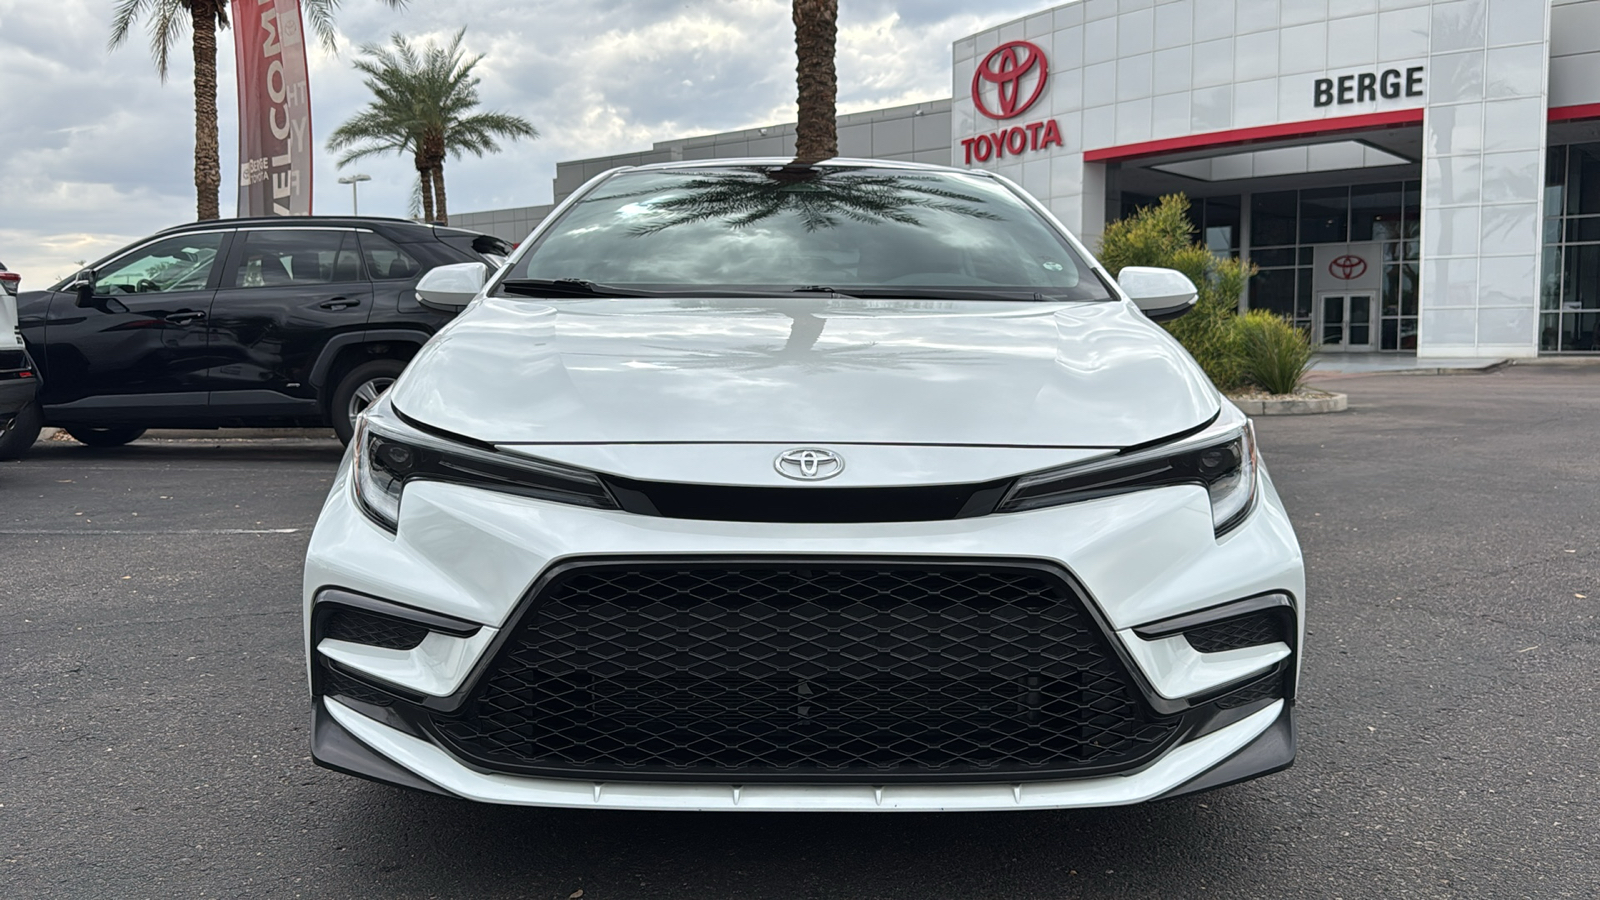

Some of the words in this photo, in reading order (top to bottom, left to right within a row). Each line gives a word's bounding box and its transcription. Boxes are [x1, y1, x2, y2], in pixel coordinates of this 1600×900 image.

[258, 0, 292, 216] ELCOM
[1313, 66, 1424, 108] BERGE
[961, 119, 1063, 165] TOYOTA
[249, 157, 269, 173] BERGE
